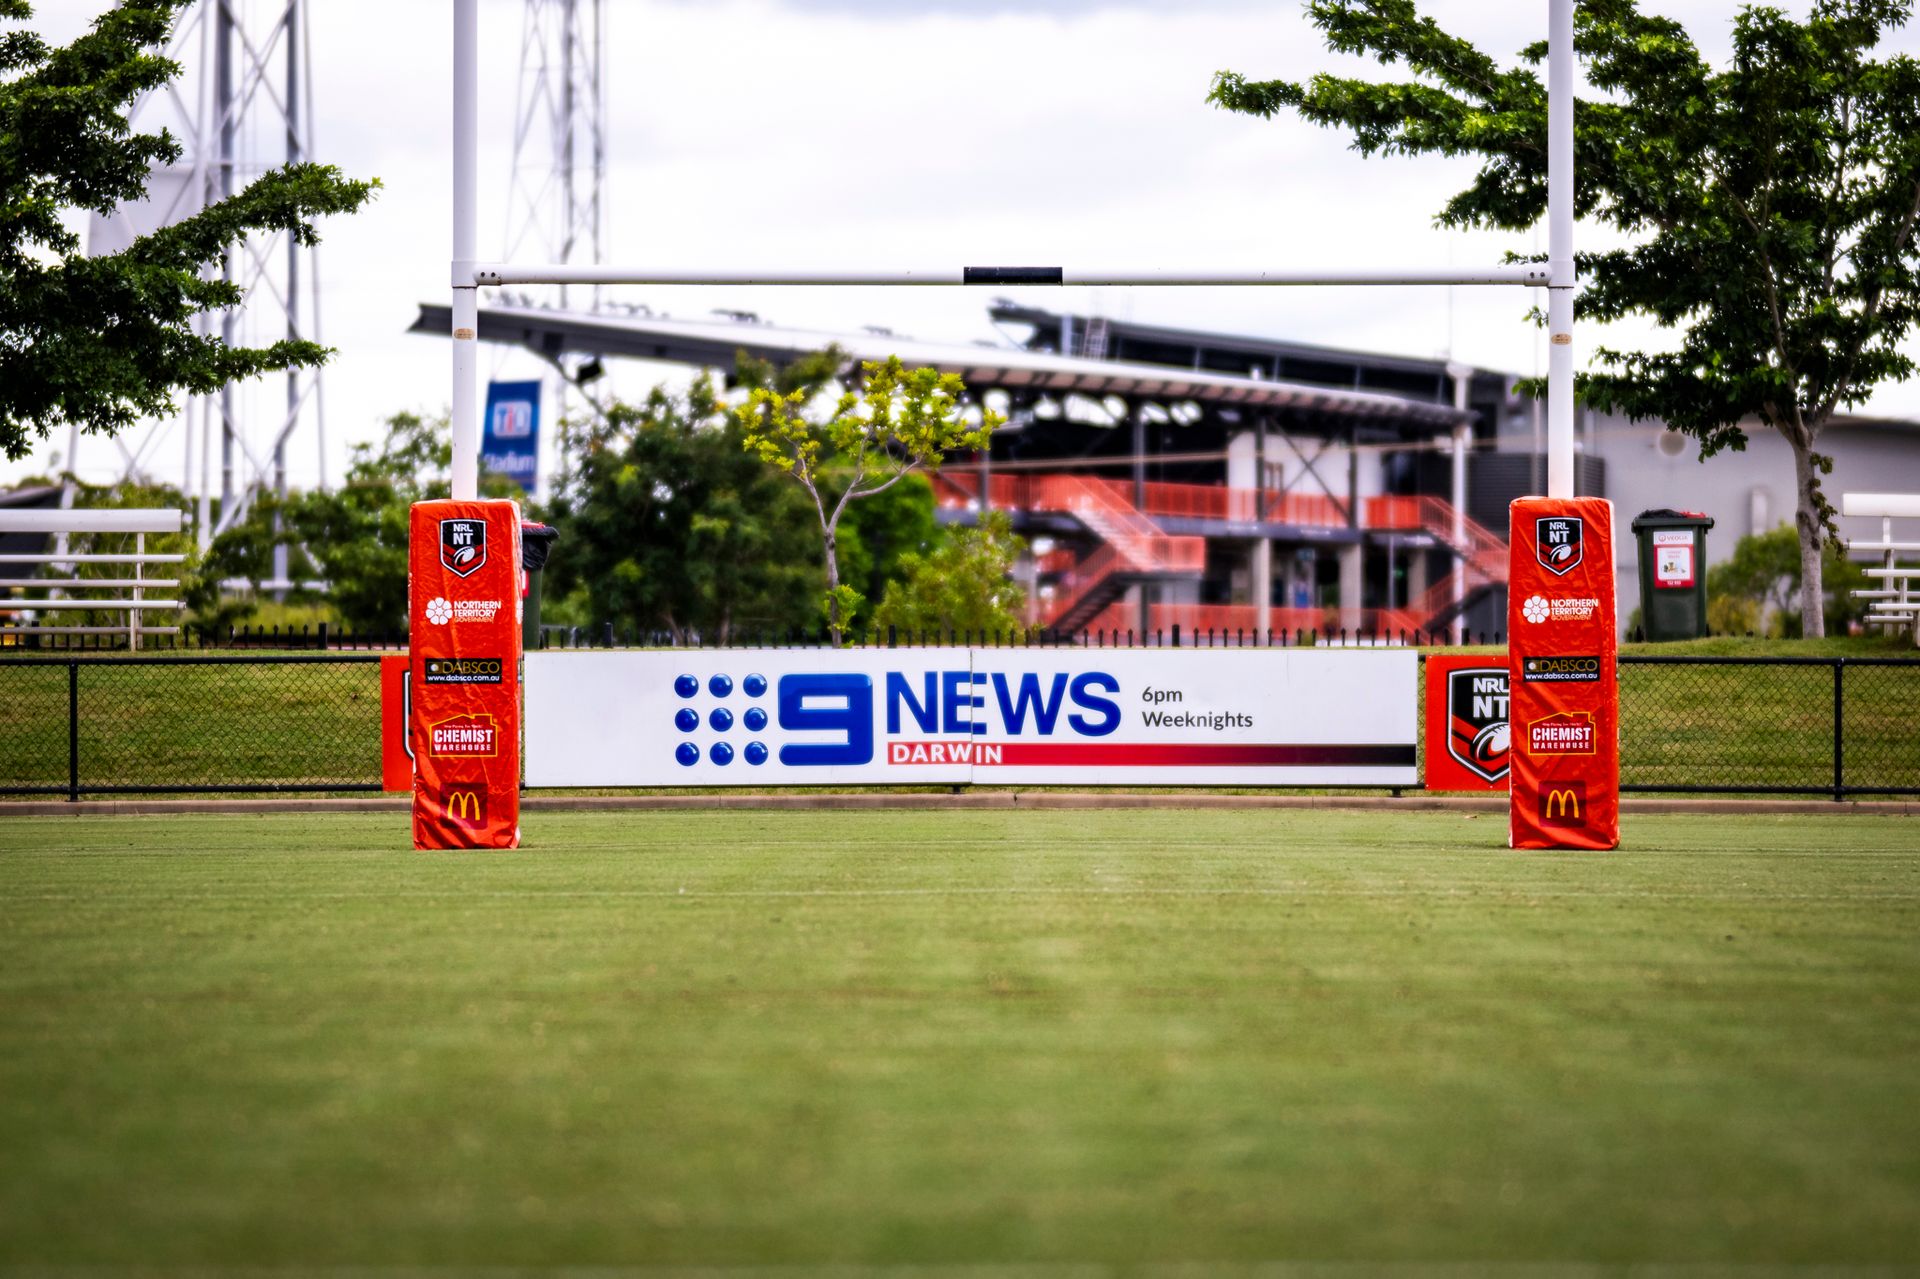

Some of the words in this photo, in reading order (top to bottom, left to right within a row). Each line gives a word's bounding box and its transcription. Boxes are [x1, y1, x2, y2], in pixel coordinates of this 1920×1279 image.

[453, 524, 473, 532] NRL
[1549, 522, 1569, 530] NRL
[453, 533, 473, 545] NT
[1549, 531, 1569, 543] NT
[453, 601, 501, 609] NORTHERN
[1551, 599, 1598, 607] NORTHERN
[453, 609, 496, 617] TERRITORY
[442, 661, 500, 674] DABSCO
[1540, 659, 1598, 672] DABSCO
[1473, 677, 1510, 693] NRL
[1142, 686, 1182, 704] 6pm
[1473, 695, 1510, 718] NT
[778, 673, 874, 766] 9
[886, 671, 1121, 736] NEWS
[1142, 711, 1253, 730] Weeknights
[434, 729, 493, 743] CHEMIST
[1532, 727, 1591, 741] CHEMIST
[893, 744, 1001, 763] DARWIN
